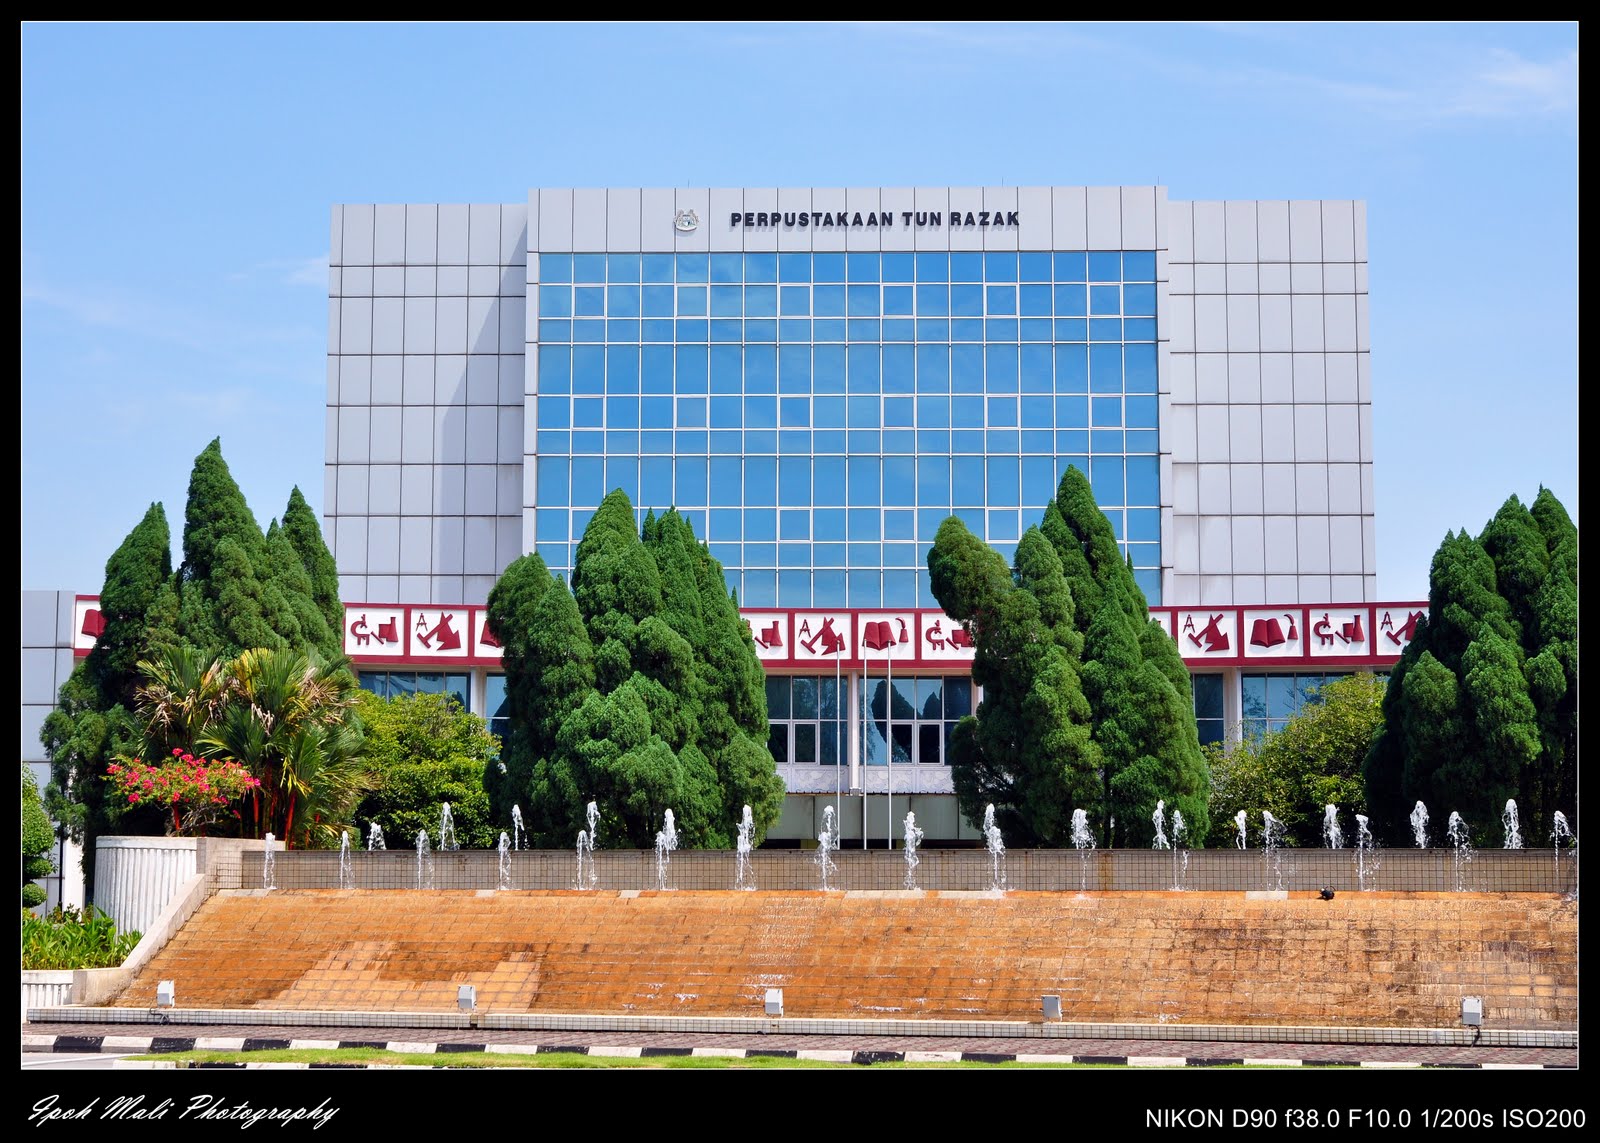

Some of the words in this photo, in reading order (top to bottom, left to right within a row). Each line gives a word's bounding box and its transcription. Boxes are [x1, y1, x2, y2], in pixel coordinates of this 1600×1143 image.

[731, 211, 893, 228] PERPUSTAKAAN
[902, 211, 942, 227] TUN
[950, 211, 1020, 227] RAZAK
